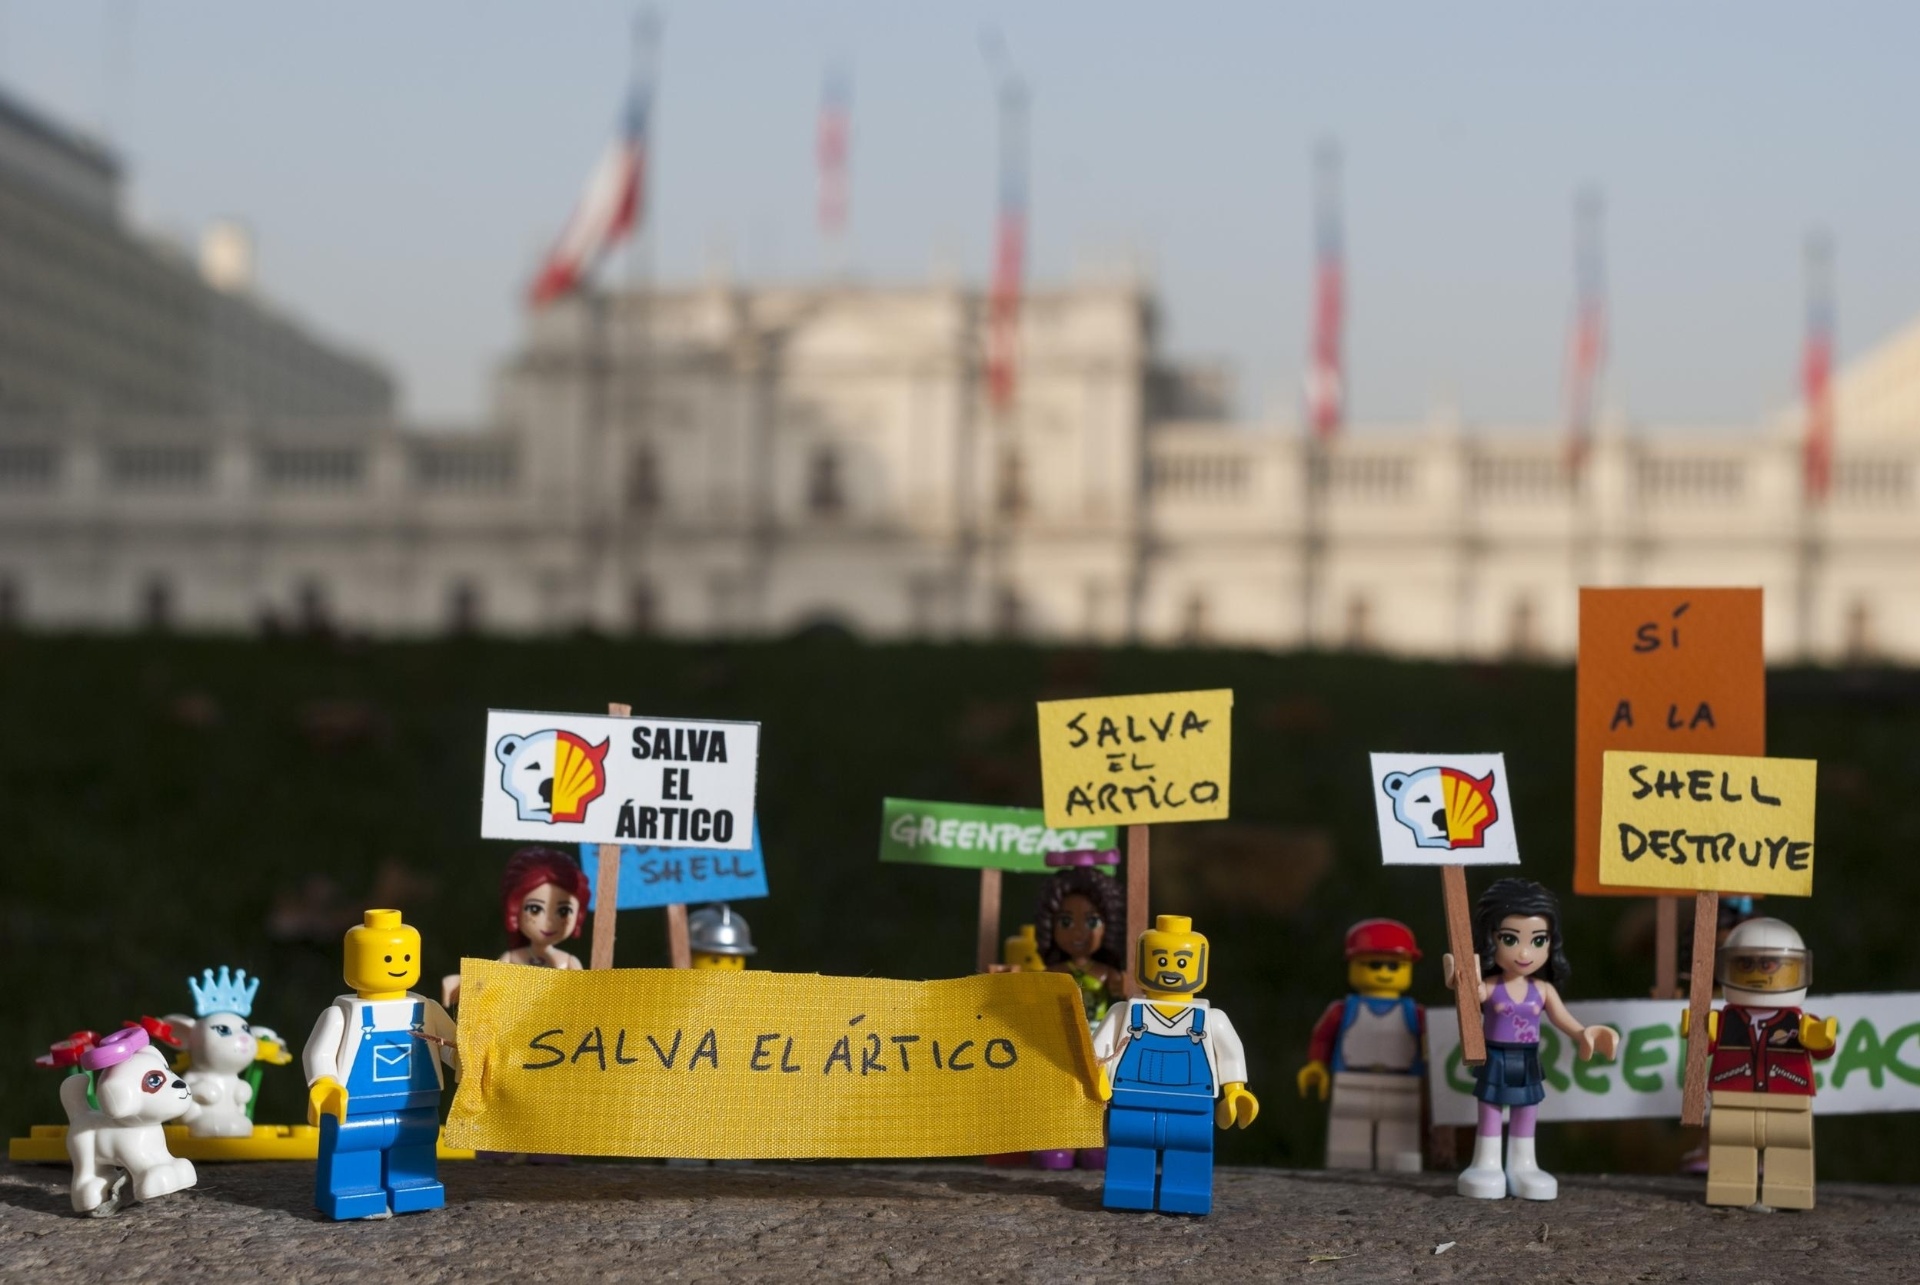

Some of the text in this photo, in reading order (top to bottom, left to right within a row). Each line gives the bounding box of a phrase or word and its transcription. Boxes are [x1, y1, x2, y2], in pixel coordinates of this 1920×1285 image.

[1632, 602, 1691, 653] SÍ
[1066, 710, 1212, 748] SALVA
[1609, 698, 1717, 731] A LA
[631, 726, 728, 763] SALVA
[1106, 752, 1155, 773] EL
[661, 767, 693, 801] EL
[1628, 764, 1782, 807] SHELL
[614, 798, 734, 843] ÁRTICO
[1618, 822, 1813, 872] DESTRUYE
[639, 854, 757, 885] SHELL
[522, 1013, 1018, 1077] SALVA EL ÁRTICO
